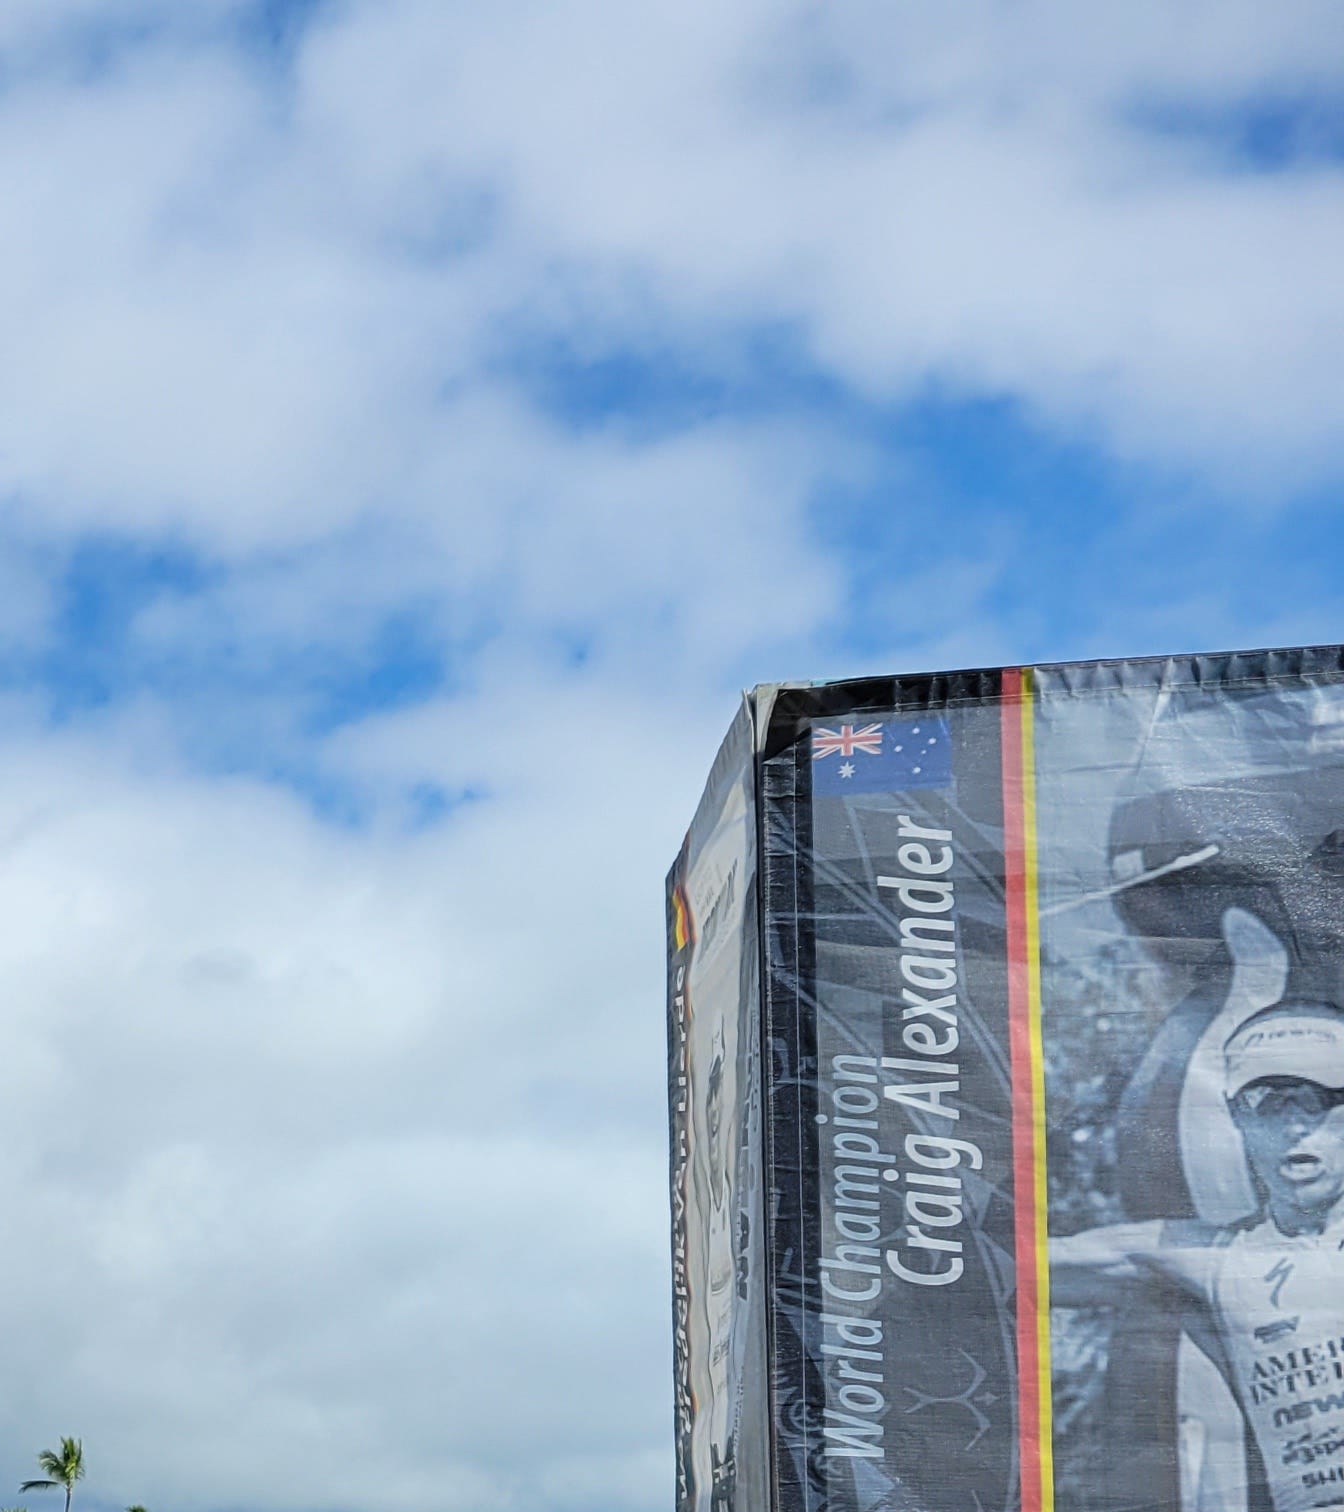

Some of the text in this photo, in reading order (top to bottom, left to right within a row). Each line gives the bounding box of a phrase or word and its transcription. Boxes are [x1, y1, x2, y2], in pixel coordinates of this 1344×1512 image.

[815, 1053, 896, 1458] World Champion
[877, 814, 983, 1286] Craig Alexander
